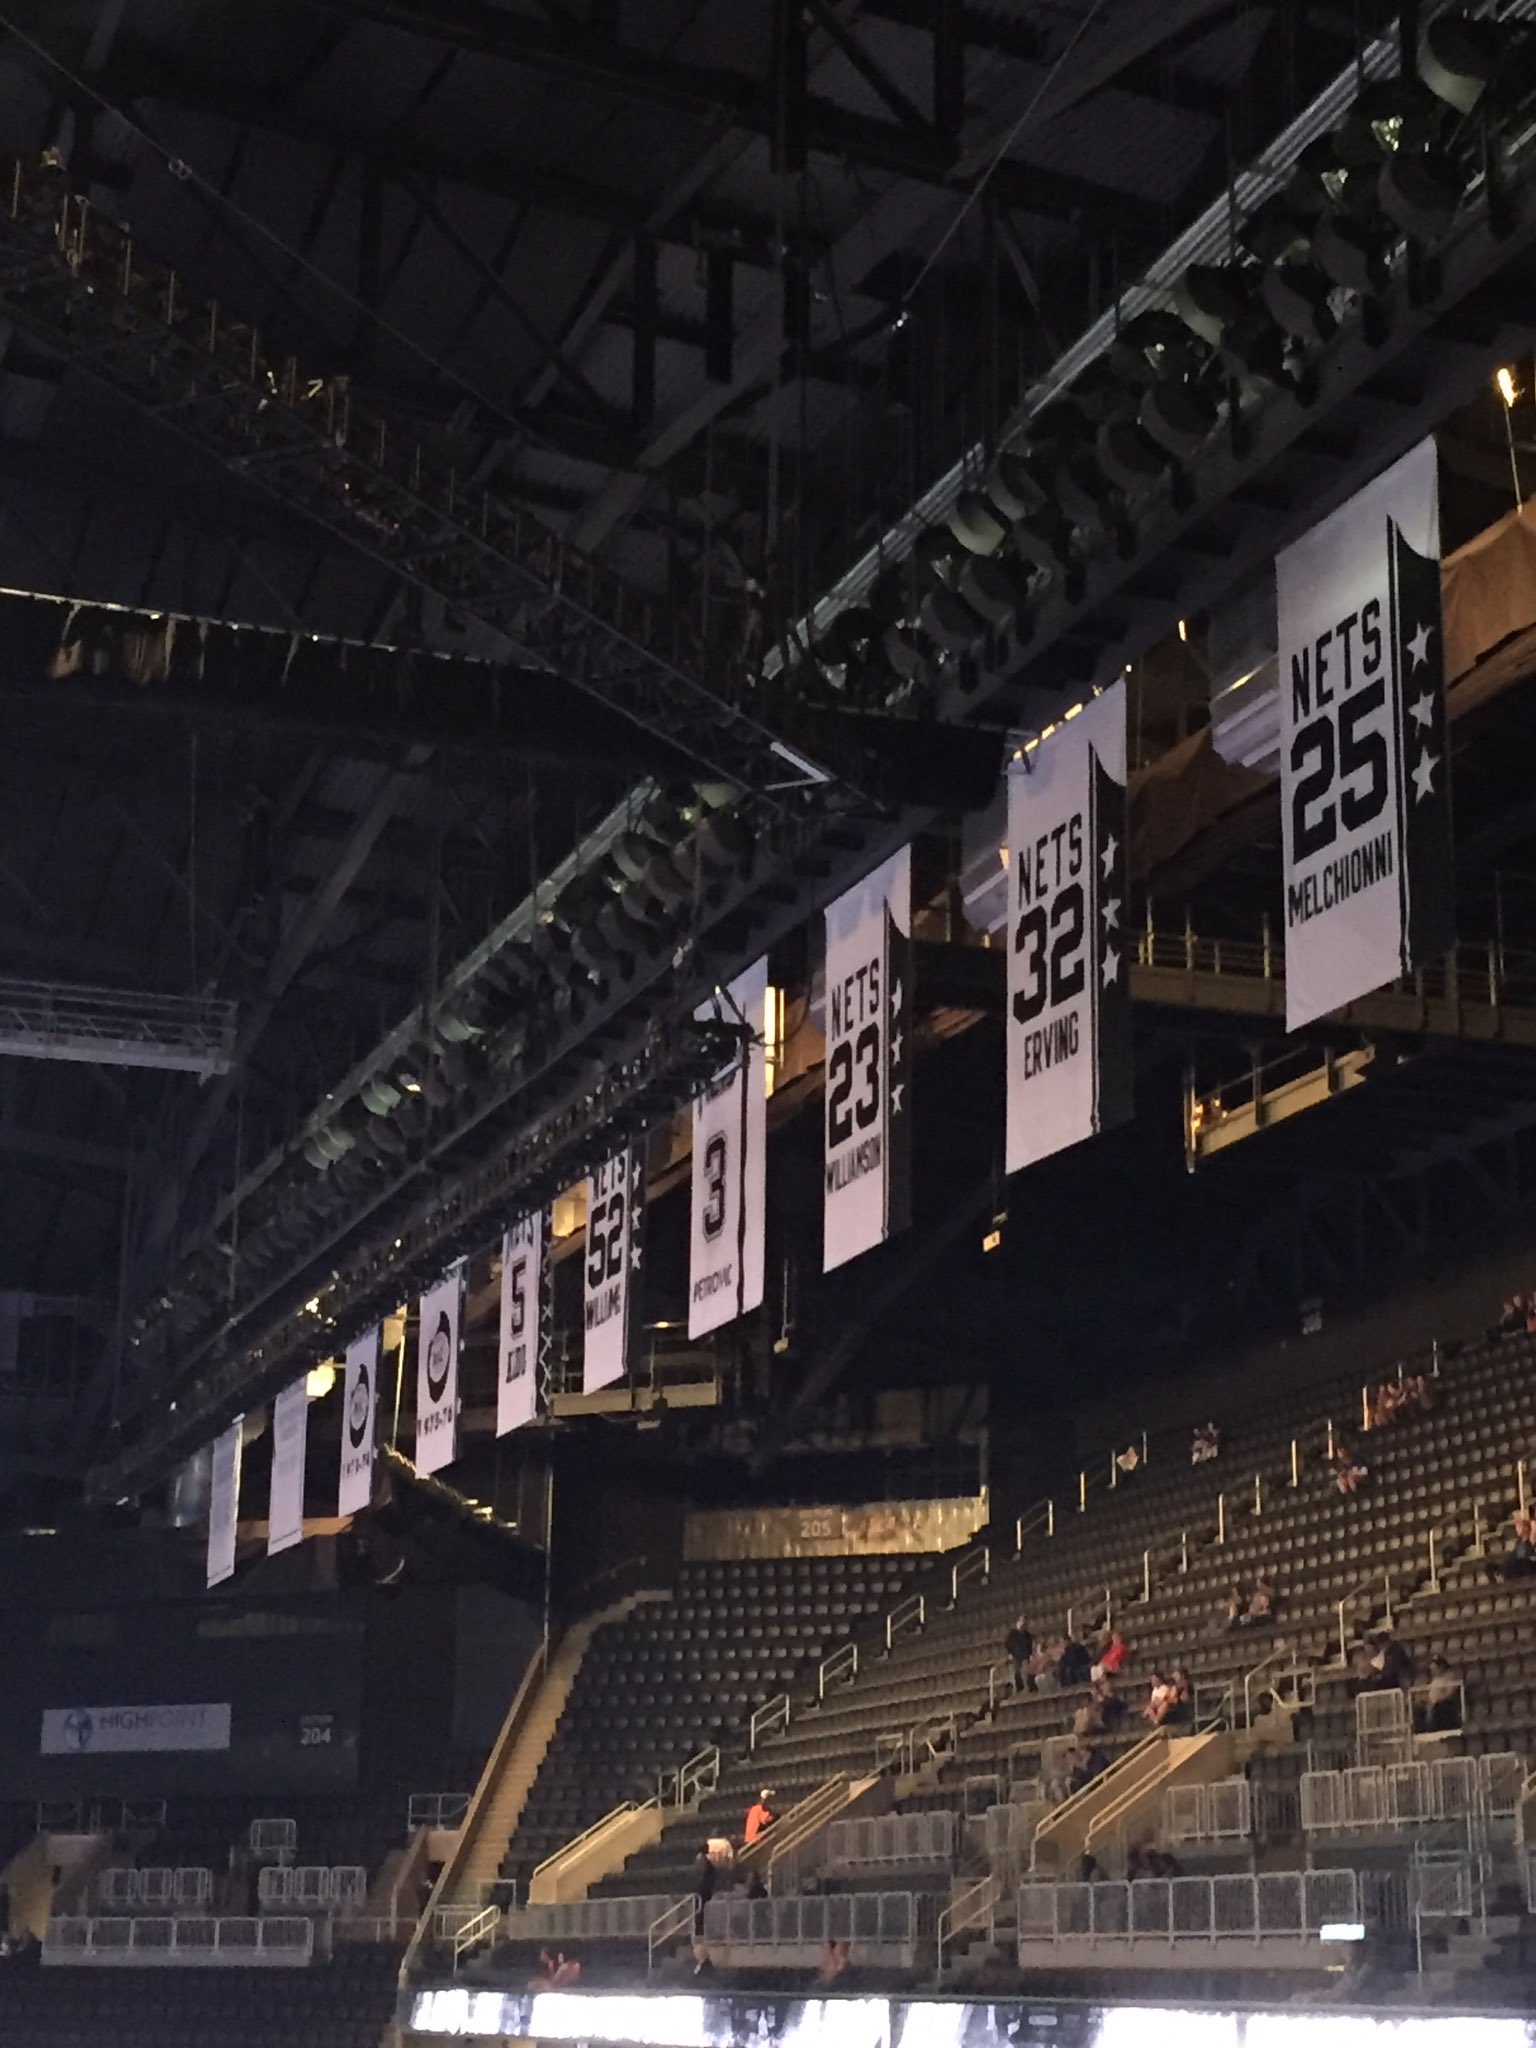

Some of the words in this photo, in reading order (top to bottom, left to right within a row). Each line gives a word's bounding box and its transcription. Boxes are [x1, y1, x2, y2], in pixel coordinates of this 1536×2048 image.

[1291, 597, 1383, 725] NETS
[1291, 676, 1388, 864] 25
[1018, 813, 1083, 909] NETS
[1288, 831, 1393, 928] MELCHIONNI
[831, 957, 880, 1042] NETS
[1013, 882, 1085, 1025] 32
[828, 1021, 881, 1147] 23
[1024, 1010, 1079, 1081] ERVING
[703, 1130, 728, 1242] 3
[588, 1191, 625, 1289] 52
[511, 1254, 527, 1341] 5
[801, 1519, 832, 1539] 205
[300, 1727, 331, 1745] 204
